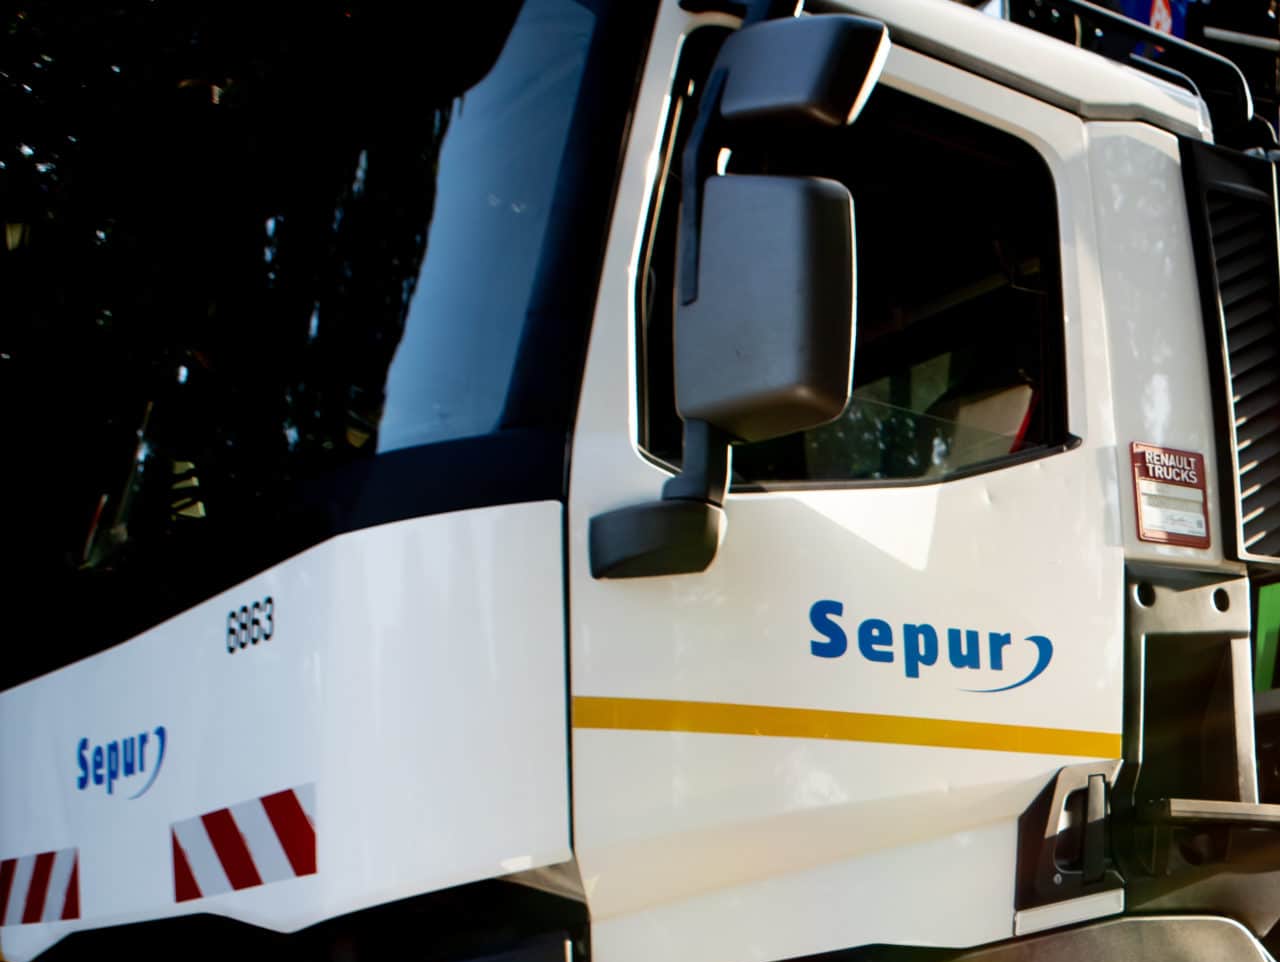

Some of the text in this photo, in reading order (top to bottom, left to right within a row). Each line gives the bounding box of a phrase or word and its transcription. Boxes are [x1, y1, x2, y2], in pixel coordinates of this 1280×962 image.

[1145, 451, 1196, 470] RENAULT
[1146, 463, 1198, 484] TRUCKS
[226, 596, 274, 655] 6863
[809, 599, 1012, 679] Sepur
[77, 731, 149, 796] Sepur
